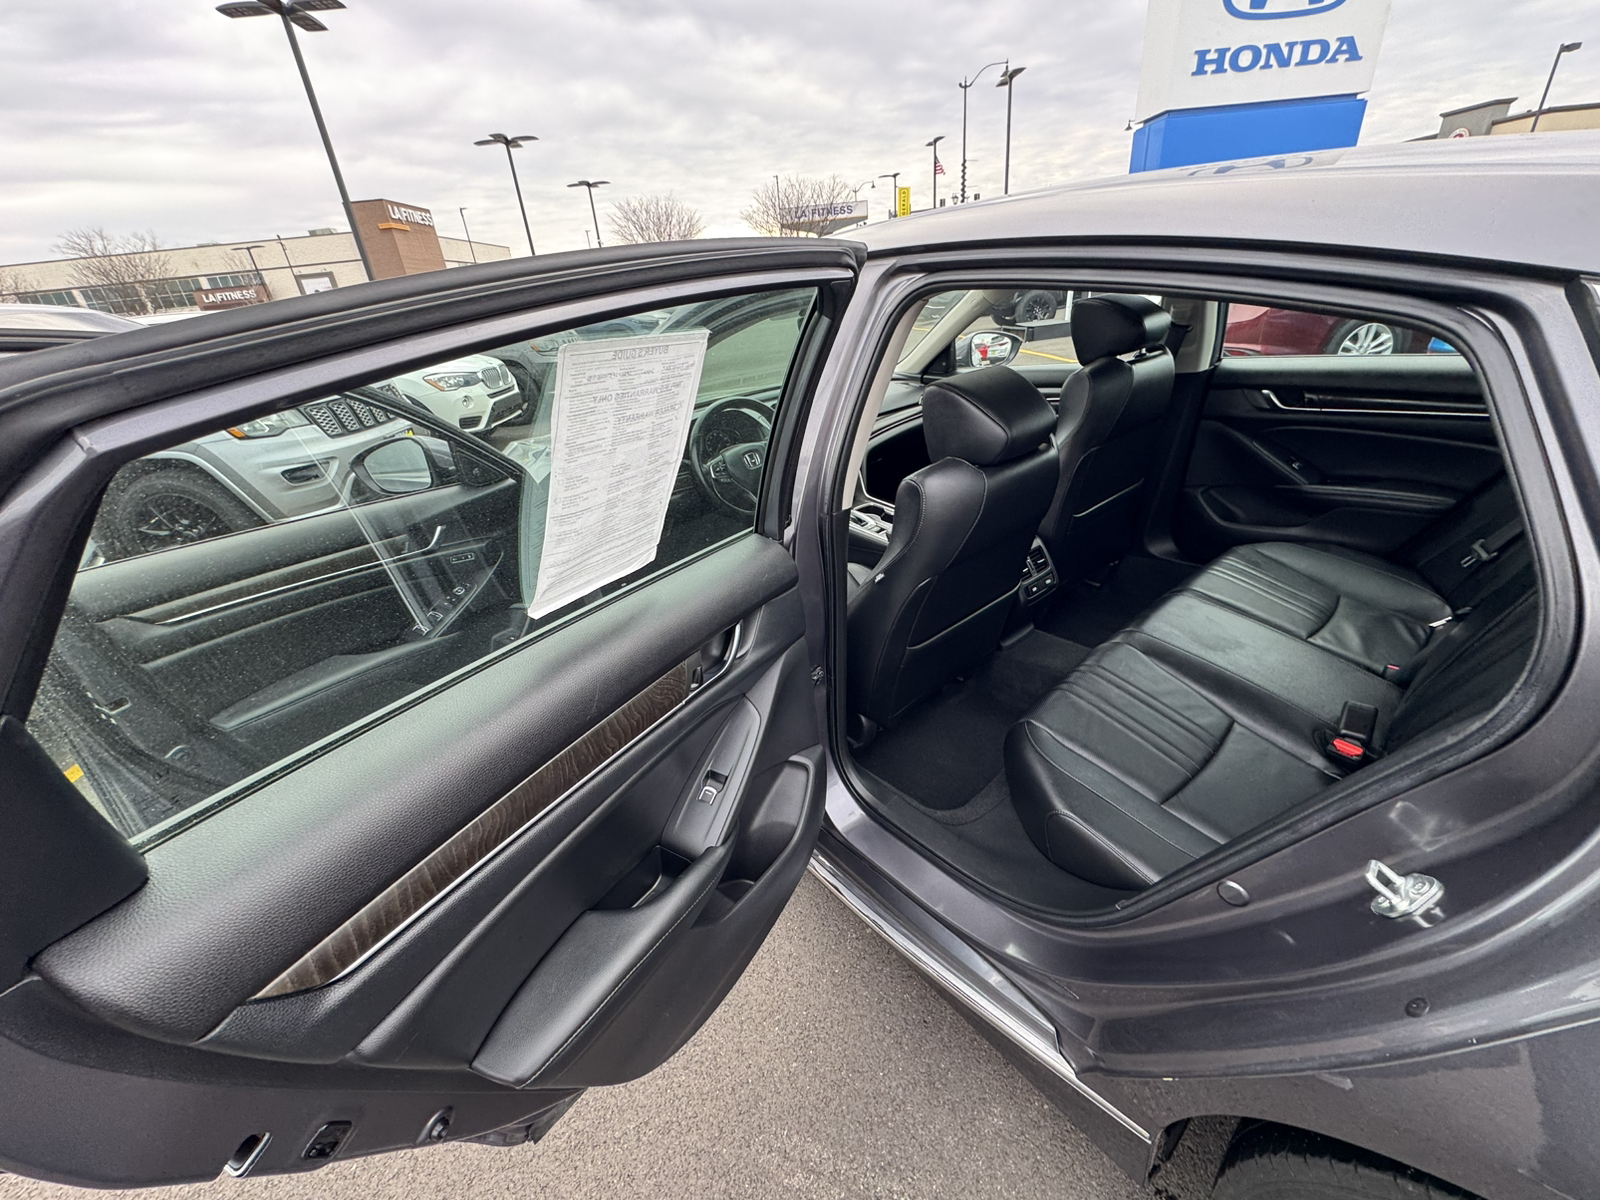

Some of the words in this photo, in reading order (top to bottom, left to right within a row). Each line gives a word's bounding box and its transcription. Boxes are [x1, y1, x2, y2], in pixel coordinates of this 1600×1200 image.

[1191, 36, 1363, 76] HONDA
[811, 205, 853, 218] FITNESS
[217, 289, 257, 302] FITNESS
